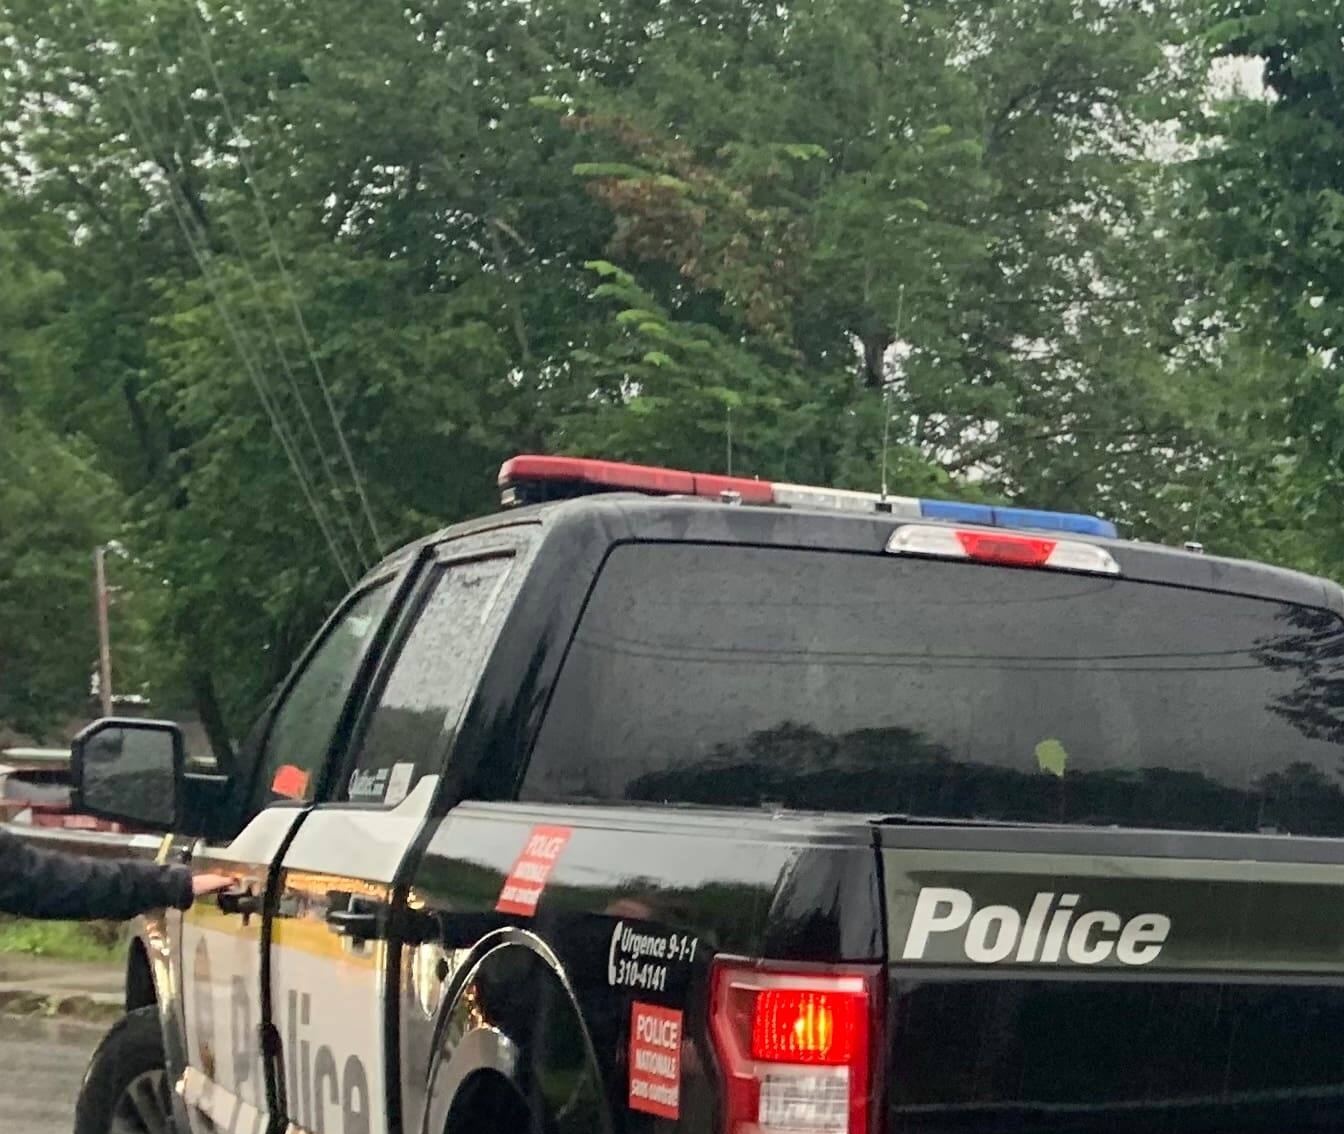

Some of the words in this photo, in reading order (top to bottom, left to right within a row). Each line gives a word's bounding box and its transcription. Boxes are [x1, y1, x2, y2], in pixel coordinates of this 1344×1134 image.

[902, 887, 1171, 965] Police
[621, 928, 666, 959] Urgence
[667, 934, 698, 962] 9-1-1
[616, 959, 666, 992] 310-4141
[636, 1014, 678, 1050] POLICE
